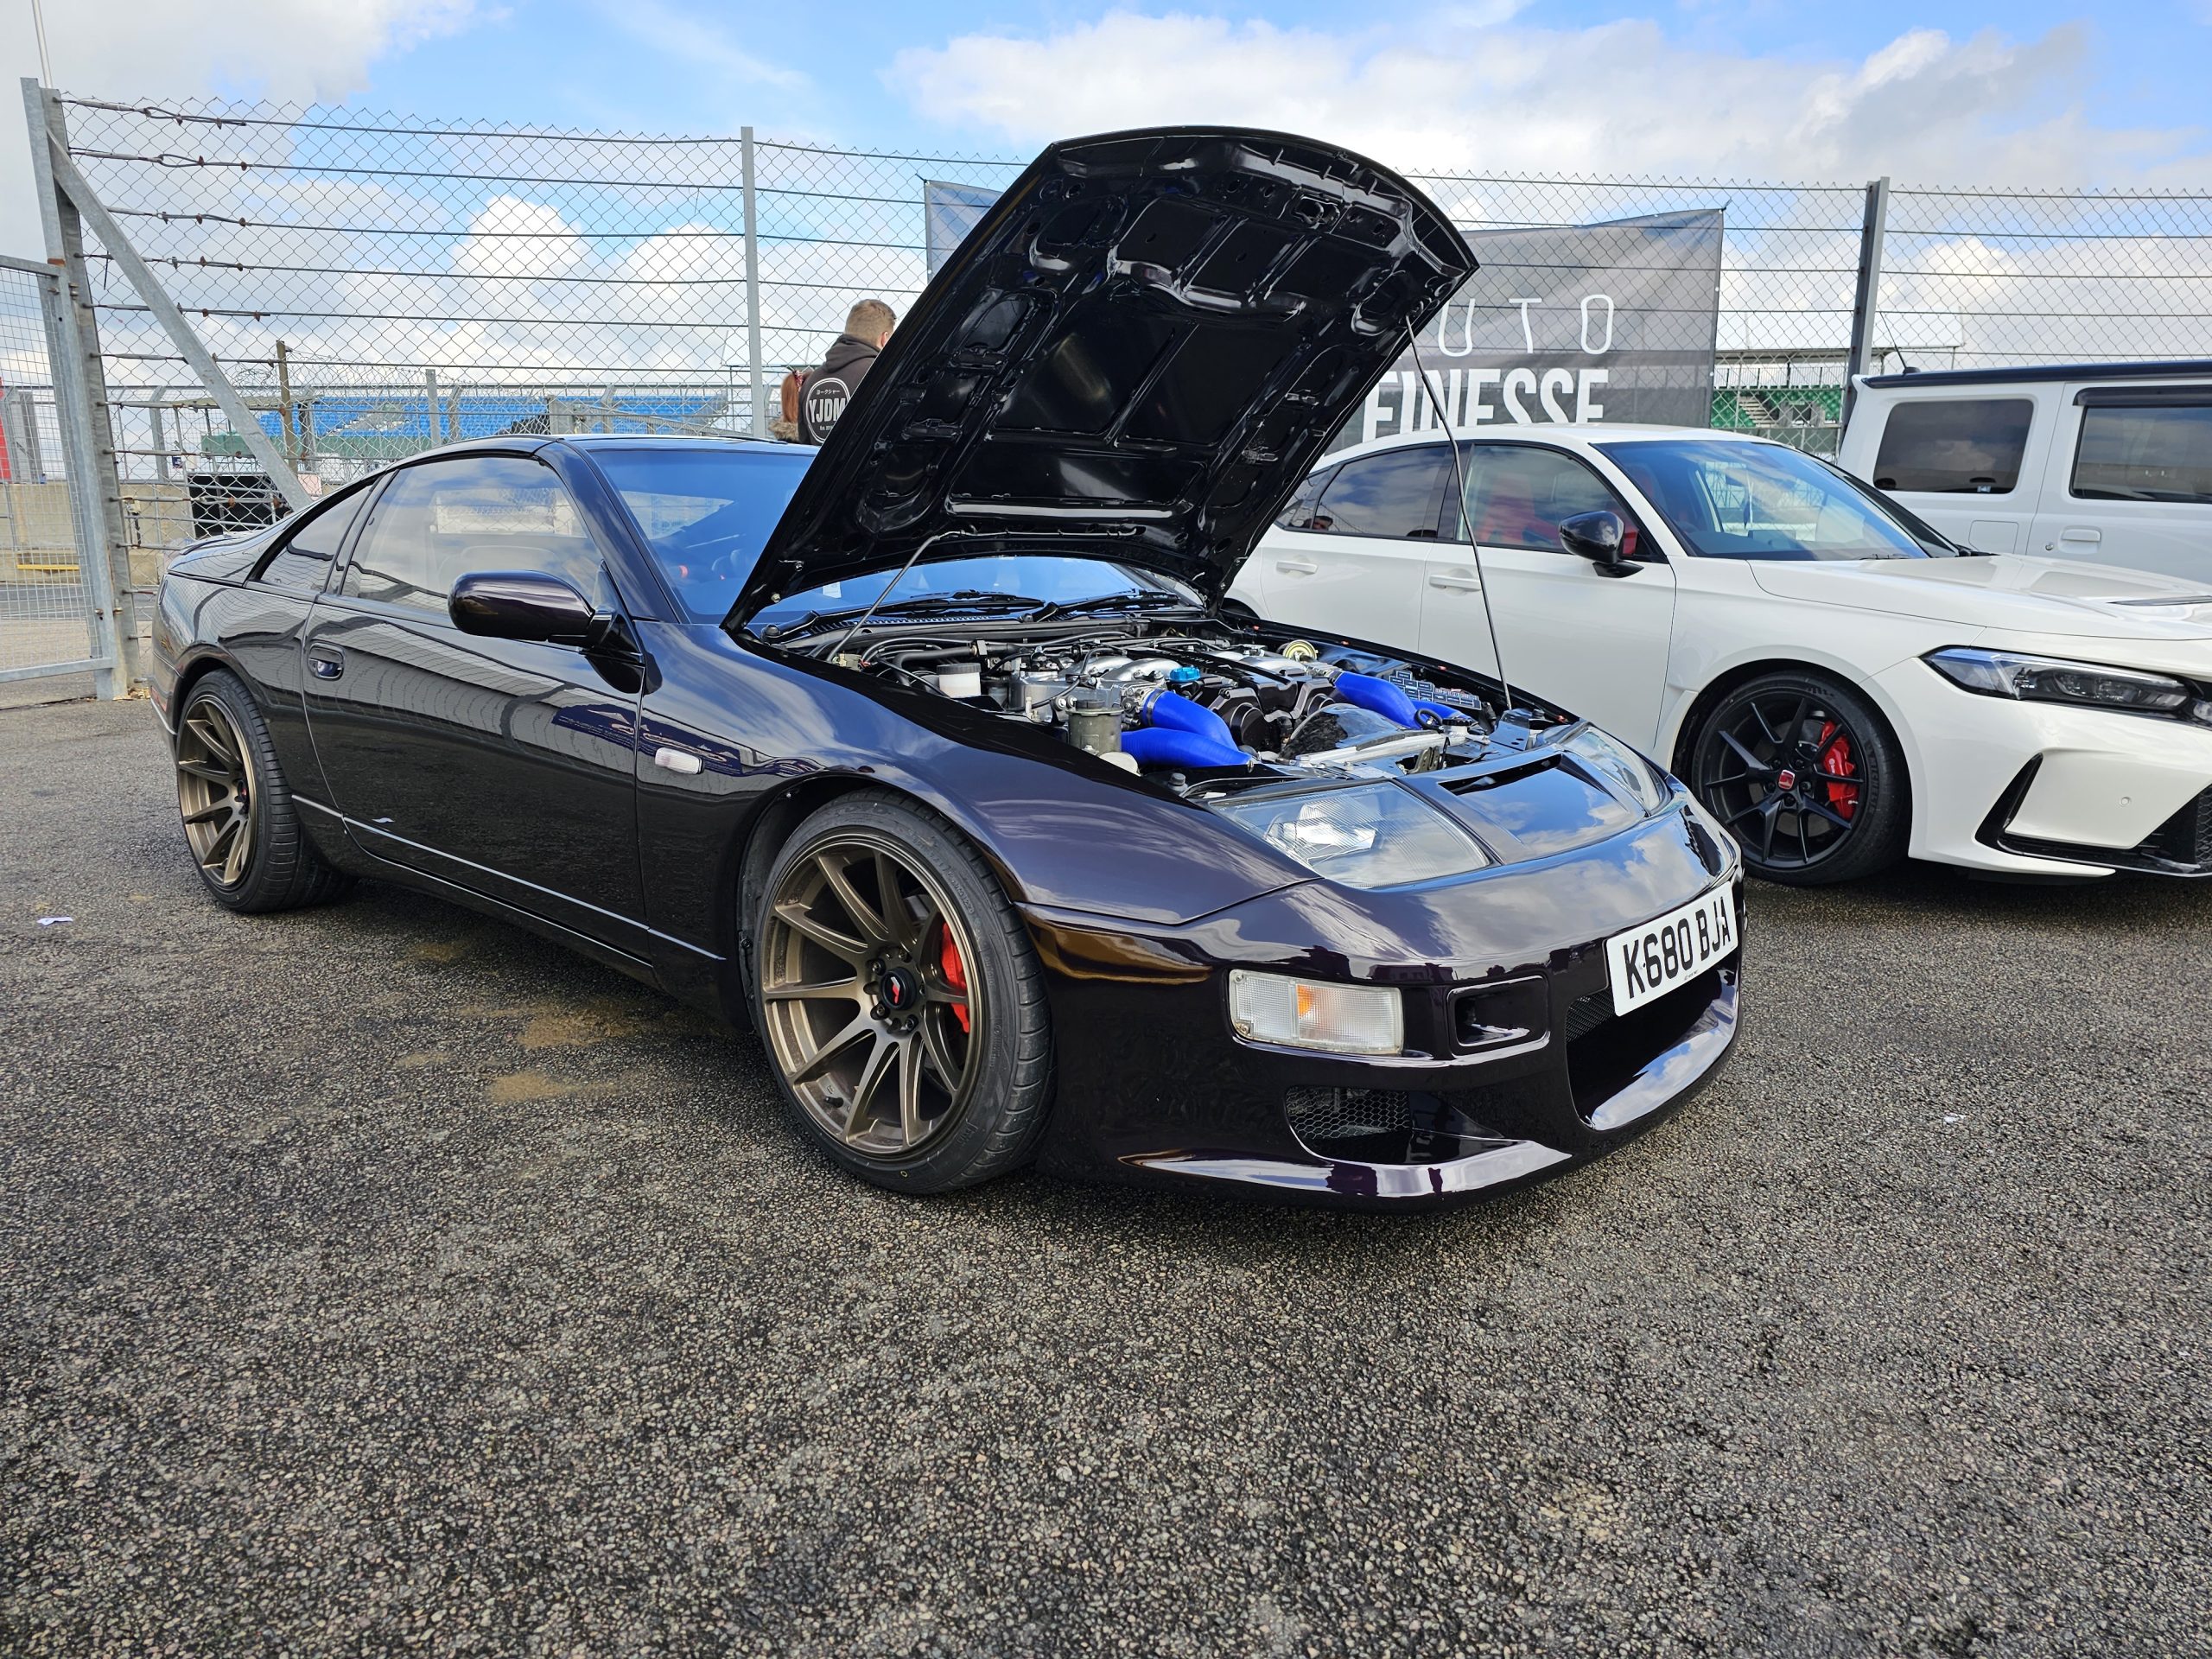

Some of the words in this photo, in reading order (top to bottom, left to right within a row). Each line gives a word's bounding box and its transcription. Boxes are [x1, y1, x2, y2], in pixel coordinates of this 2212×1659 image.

[1438, 294, 1614, 357] UTO
[809, 397, 846, 423] YJDM
[1363, 368, 1609, 442] FINESSE
[1623, 918, 1694, 999] K680
[1695, 896, 1731, 961] BJA
